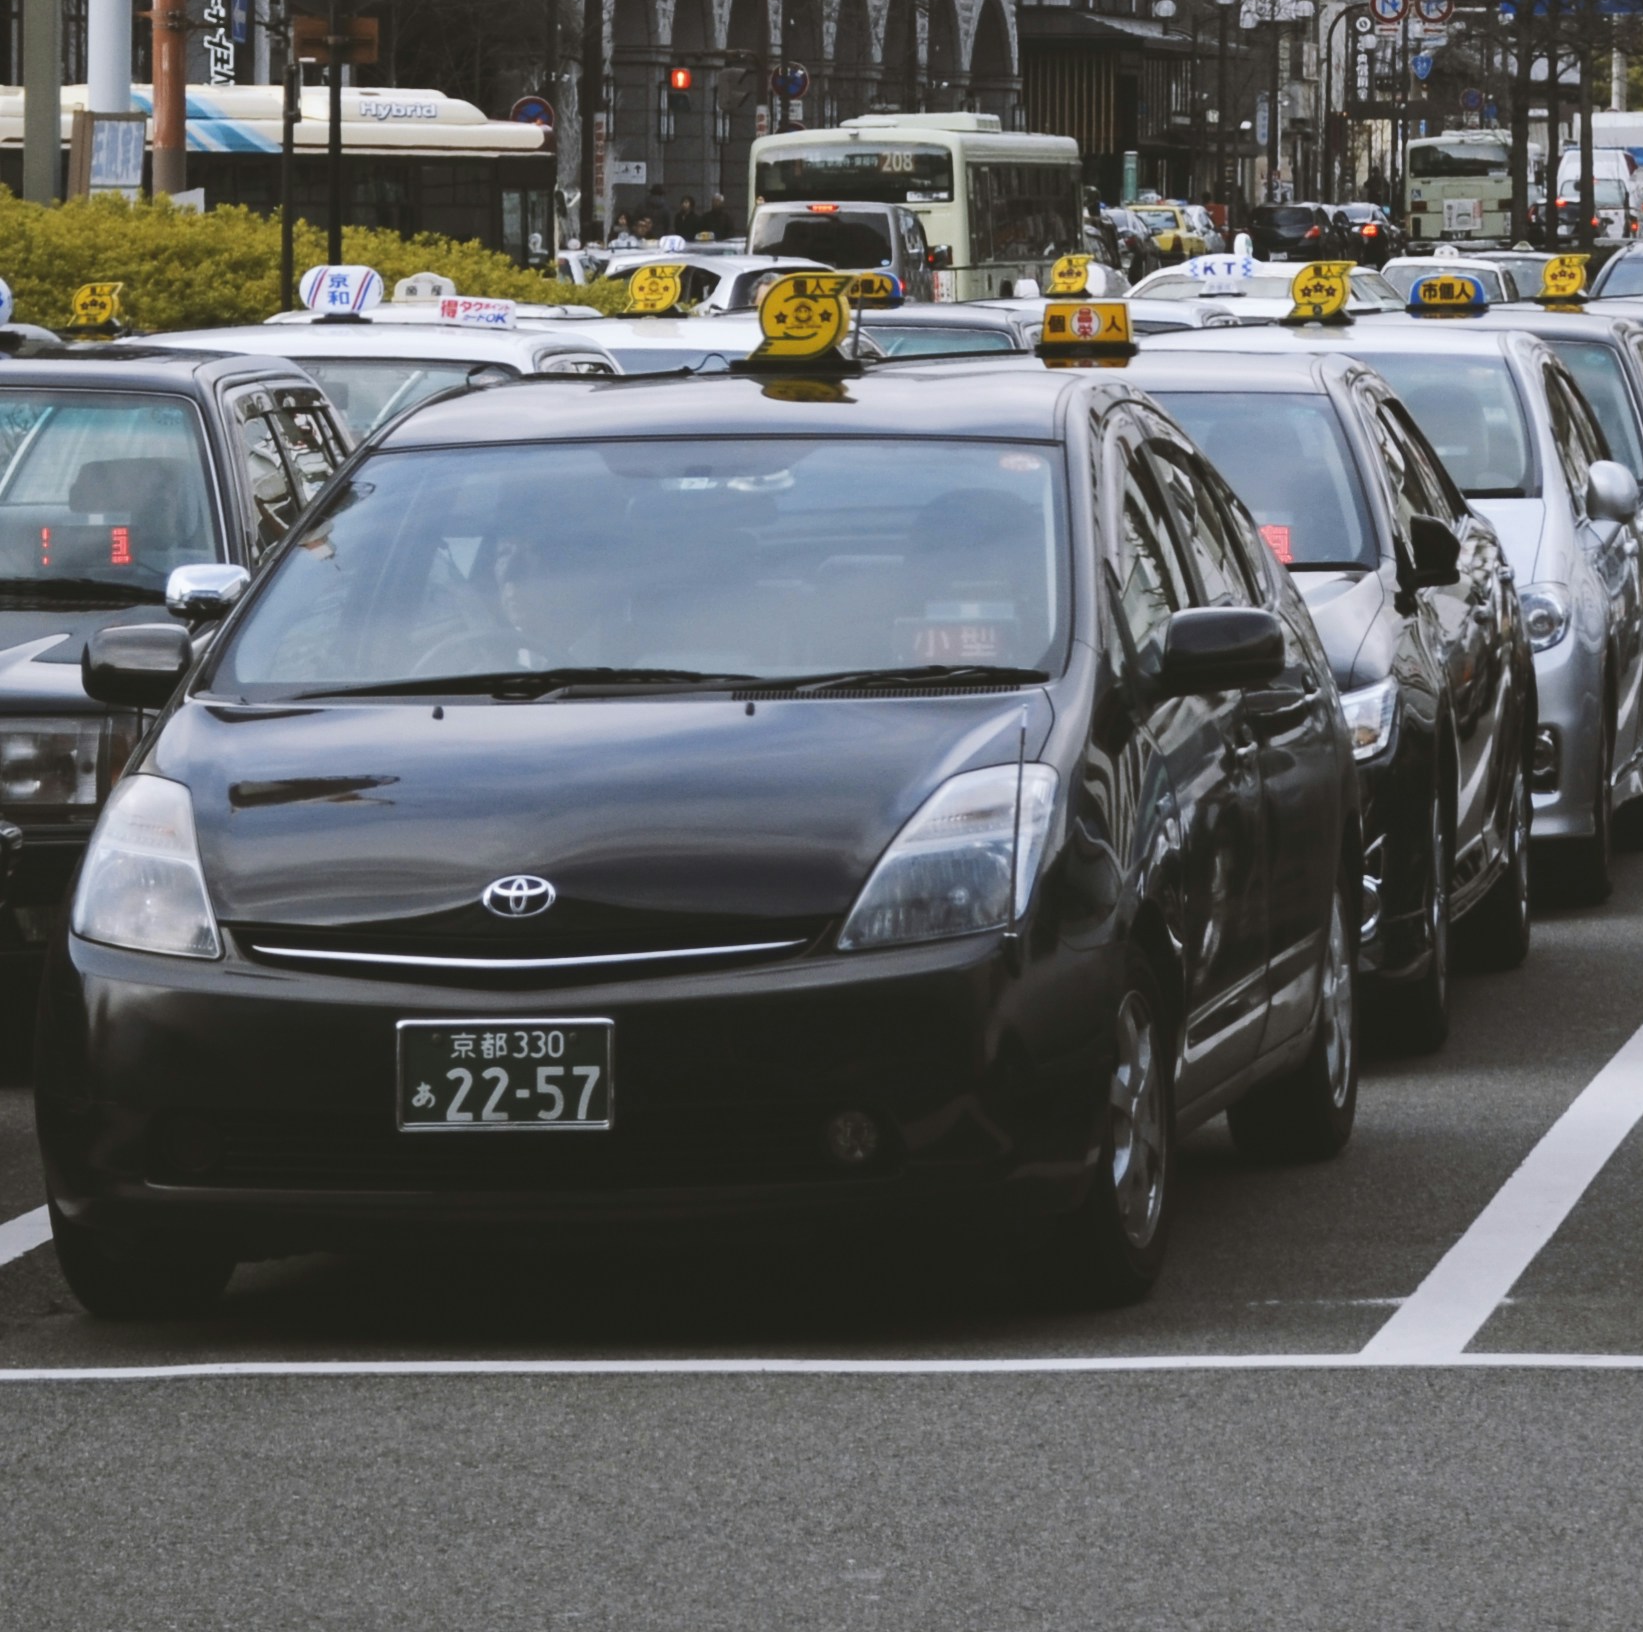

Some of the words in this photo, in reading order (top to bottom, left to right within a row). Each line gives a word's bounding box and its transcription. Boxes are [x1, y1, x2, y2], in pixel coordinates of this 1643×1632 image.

[882, 152, 914, 171] 208
[328, 274, 349, 305] 京和
[793, 281, 824, 296] 個人
[1422, 282, 1474, 302] 市個人
[441, 299, 458, 318] 得
[1048, 315, 1066, 332] 個
[1104, 315, 1122, 333] 人
[450, 1032, 507, 1058] 京都
[512, 1031, 565, 1058] 330
[411, 1082, 436, 1108] あ
[446, 1066, 600, 1122] 22-57
